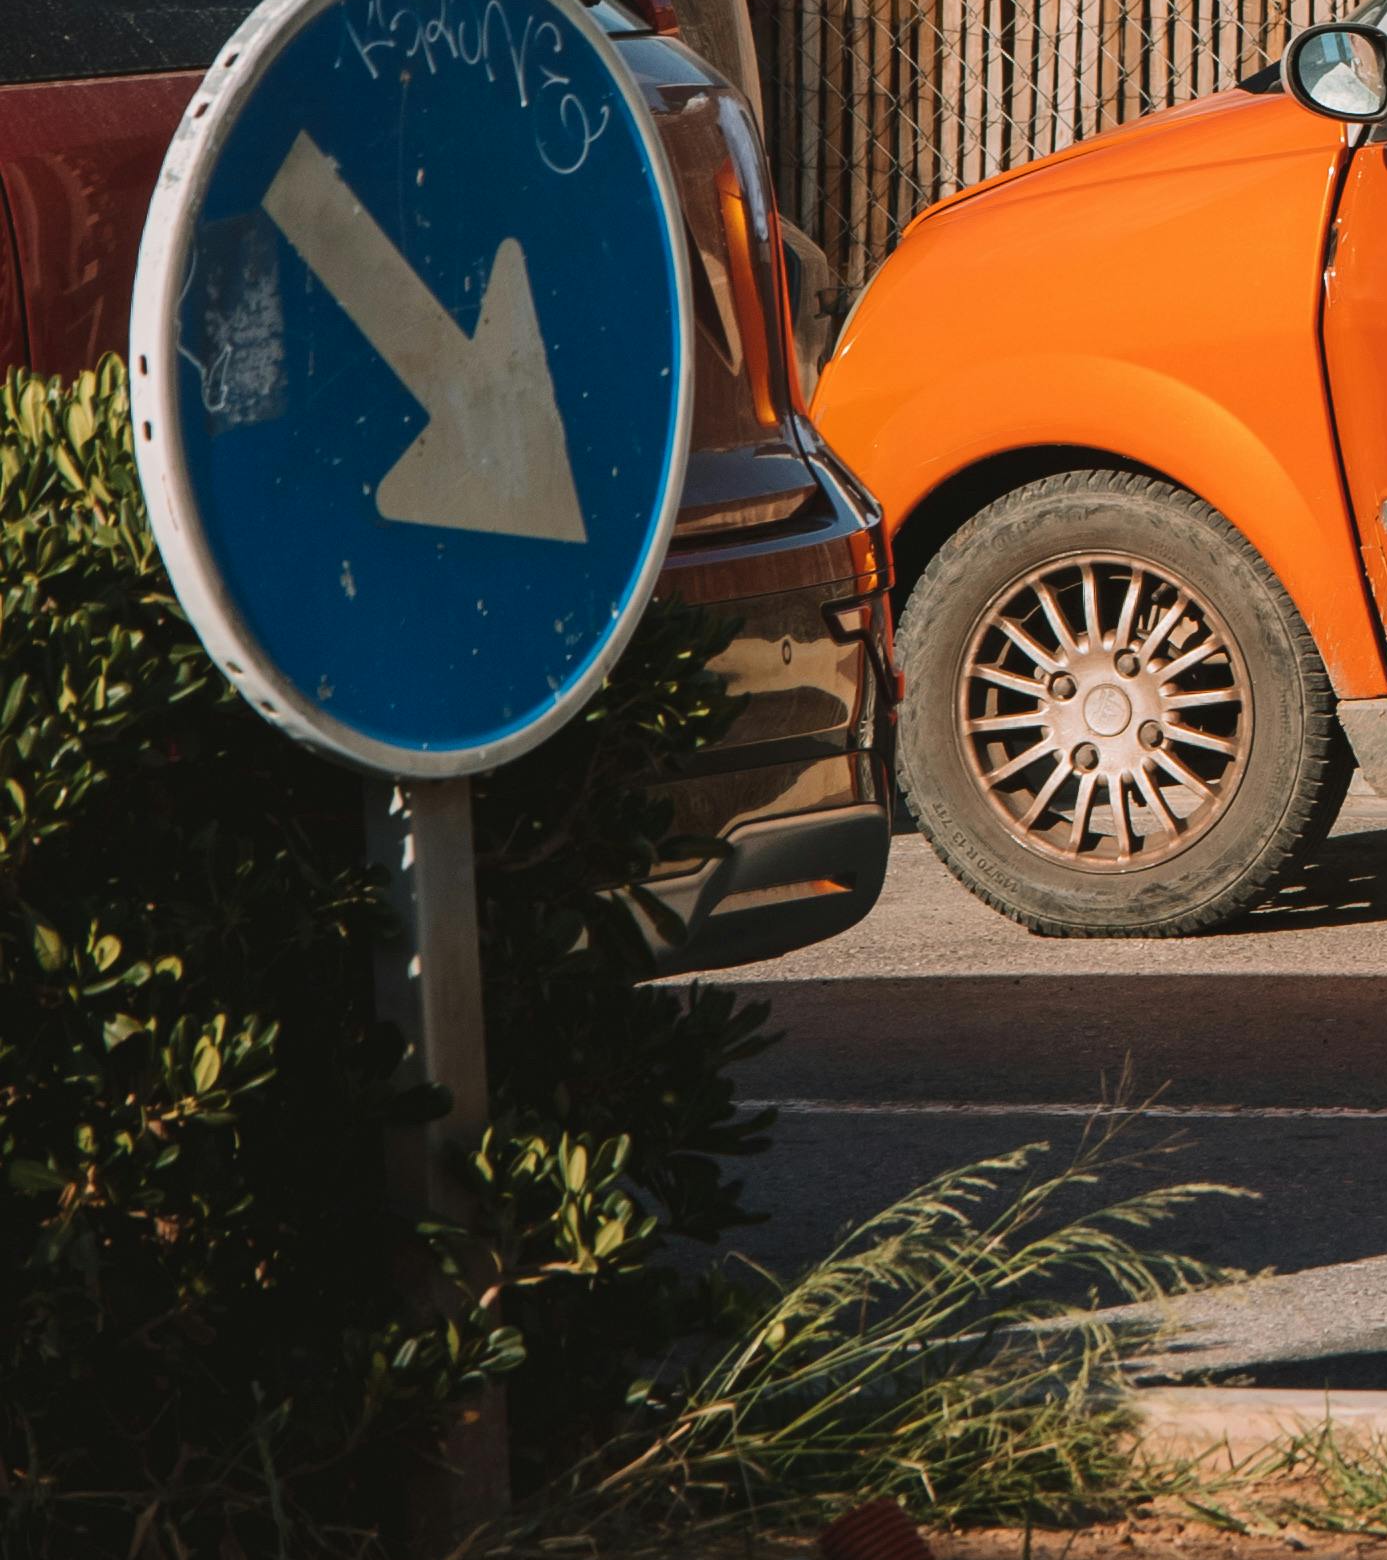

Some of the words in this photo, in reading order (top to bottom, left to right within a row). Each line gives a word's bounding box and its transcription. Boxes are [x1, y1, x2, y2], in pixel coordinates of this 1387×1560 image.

[952, 831, 969, 849] 13
[966, 846, 980, 861] R
[977, 859, 1019, 894] 145/70
